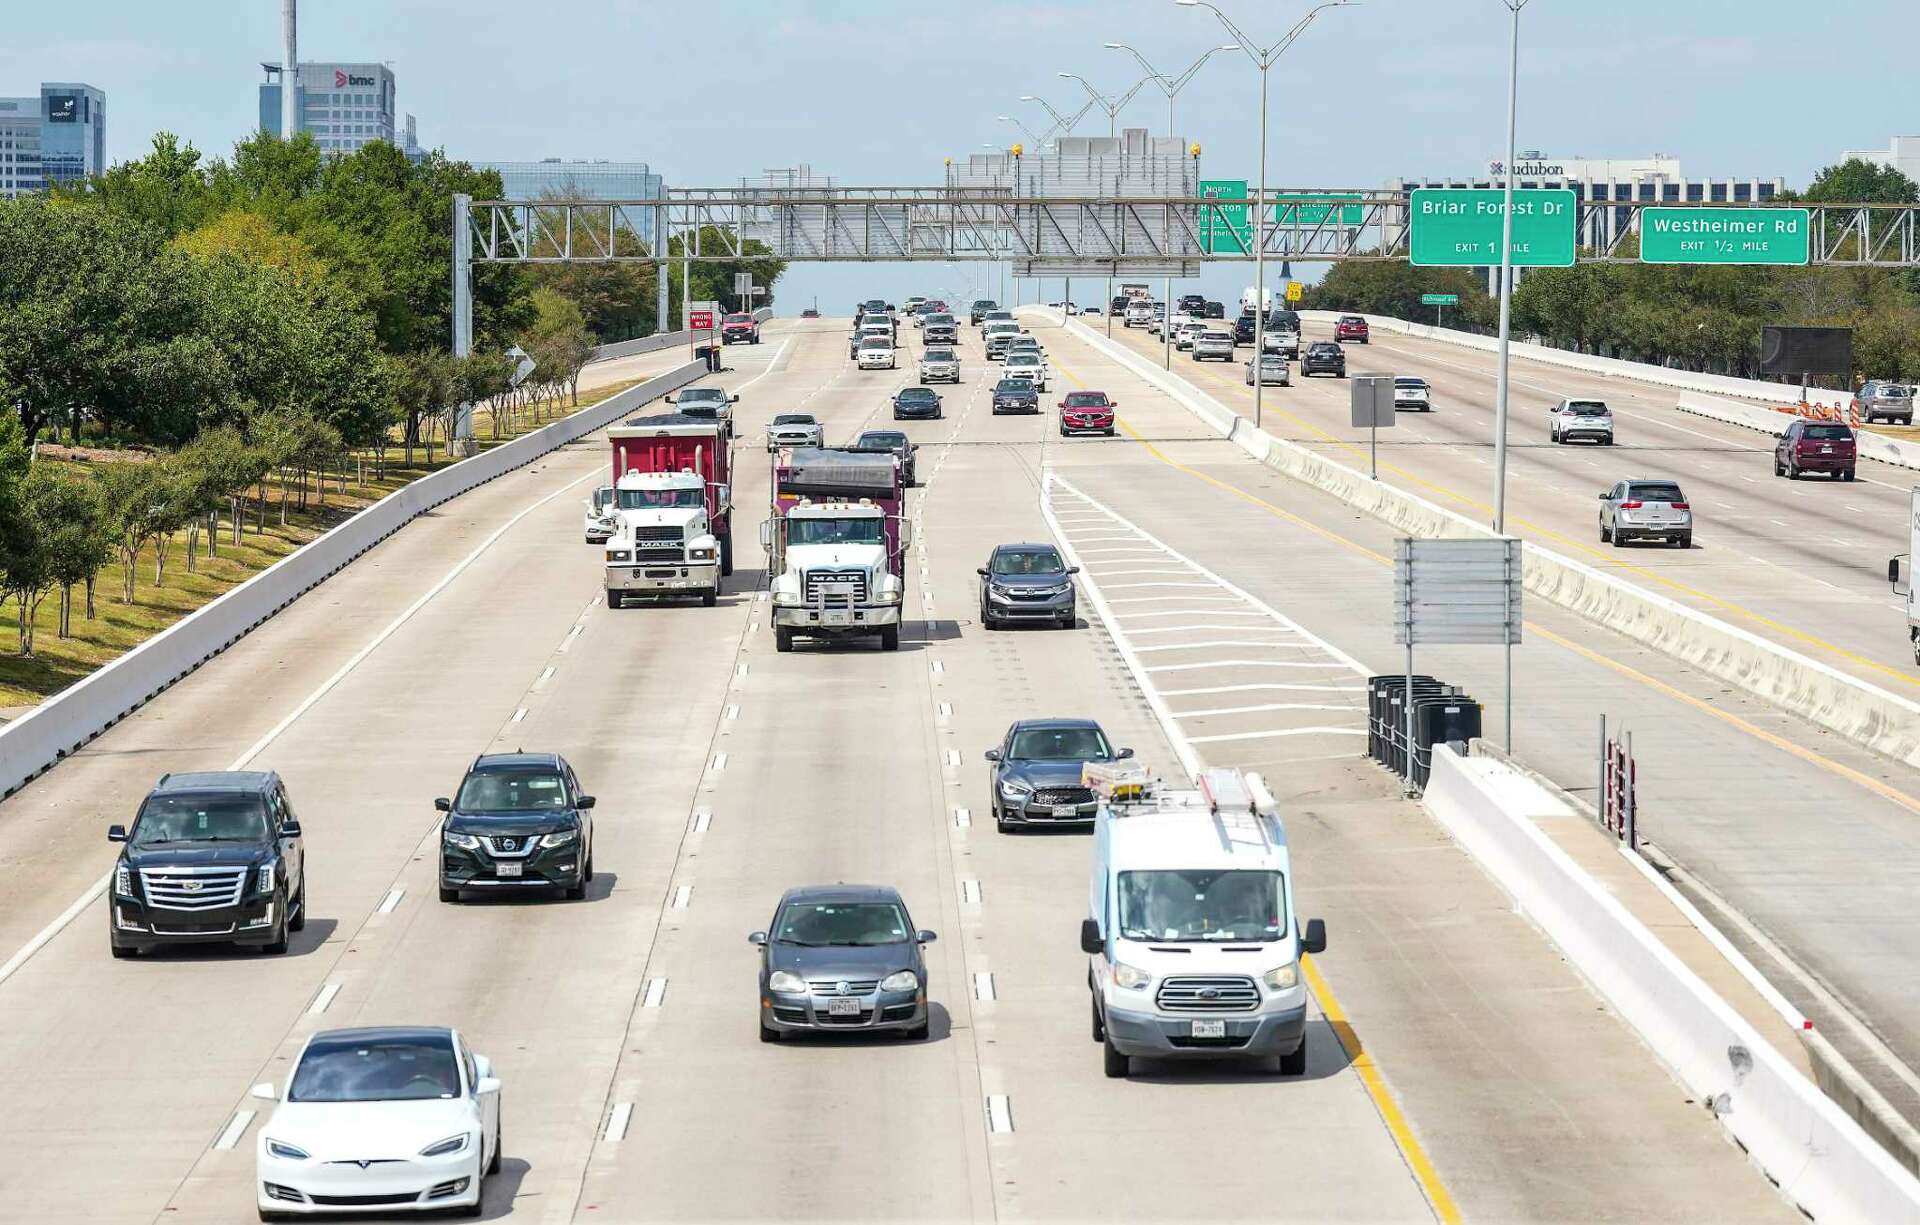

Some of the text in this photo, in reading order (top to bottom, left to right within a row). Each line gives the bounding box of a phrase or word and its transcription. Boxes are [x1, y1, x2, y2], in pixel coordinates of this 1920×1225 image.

[349, 74, 375, 86] bmc
[1504, 162, 1563, 176] udubon
[1422, 200, 1467, 215] Briar
[1544, 201, 1563, 215] Dr
[1654, 219, 1797, 233] Westheimer Rd
[1455, 242, 1530, 254] EXIT 1 ILE
[1681, 240, 1769, 252] EXIT 1/2 MILE
